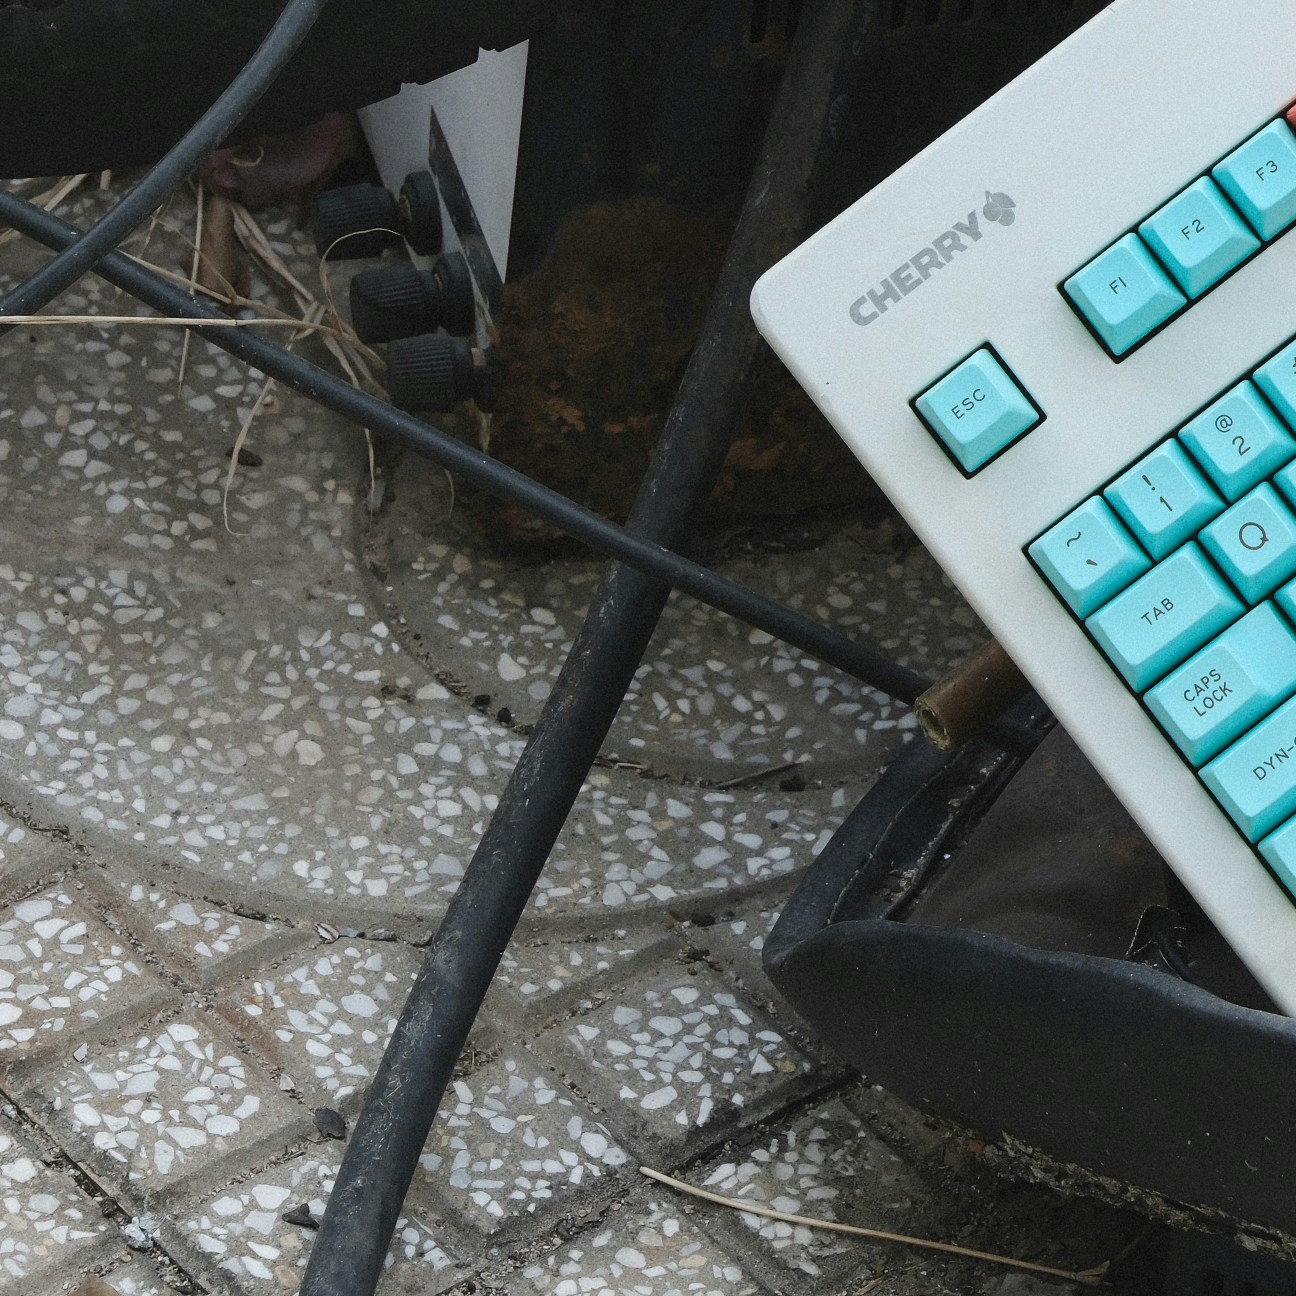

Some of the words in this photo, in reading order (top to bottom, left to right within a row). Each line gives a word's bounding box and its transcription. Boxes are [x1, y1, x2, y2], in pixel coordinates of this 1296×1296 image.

[1256, 160, 1278, 181] F3
[1181, 219, 1205, 240] F2
[848, 211, 984, 327] CHERRY
[1109, 277, 1127, 294] F1
[951, 389, 985, 419] ESC
[1215, 414, 1233, 433] @
[1232, 436, 1251, 456] 2
[1142, 475, 1155, 491] !
[1160, 496, 1172, 511] 1
[1239, 522, 1268, 550] Q
[1141, 598, 1174, 624] TAB
[1183, 668, 1222, 702] CAPS
[1193, 681, 1234, 717] LOCK
